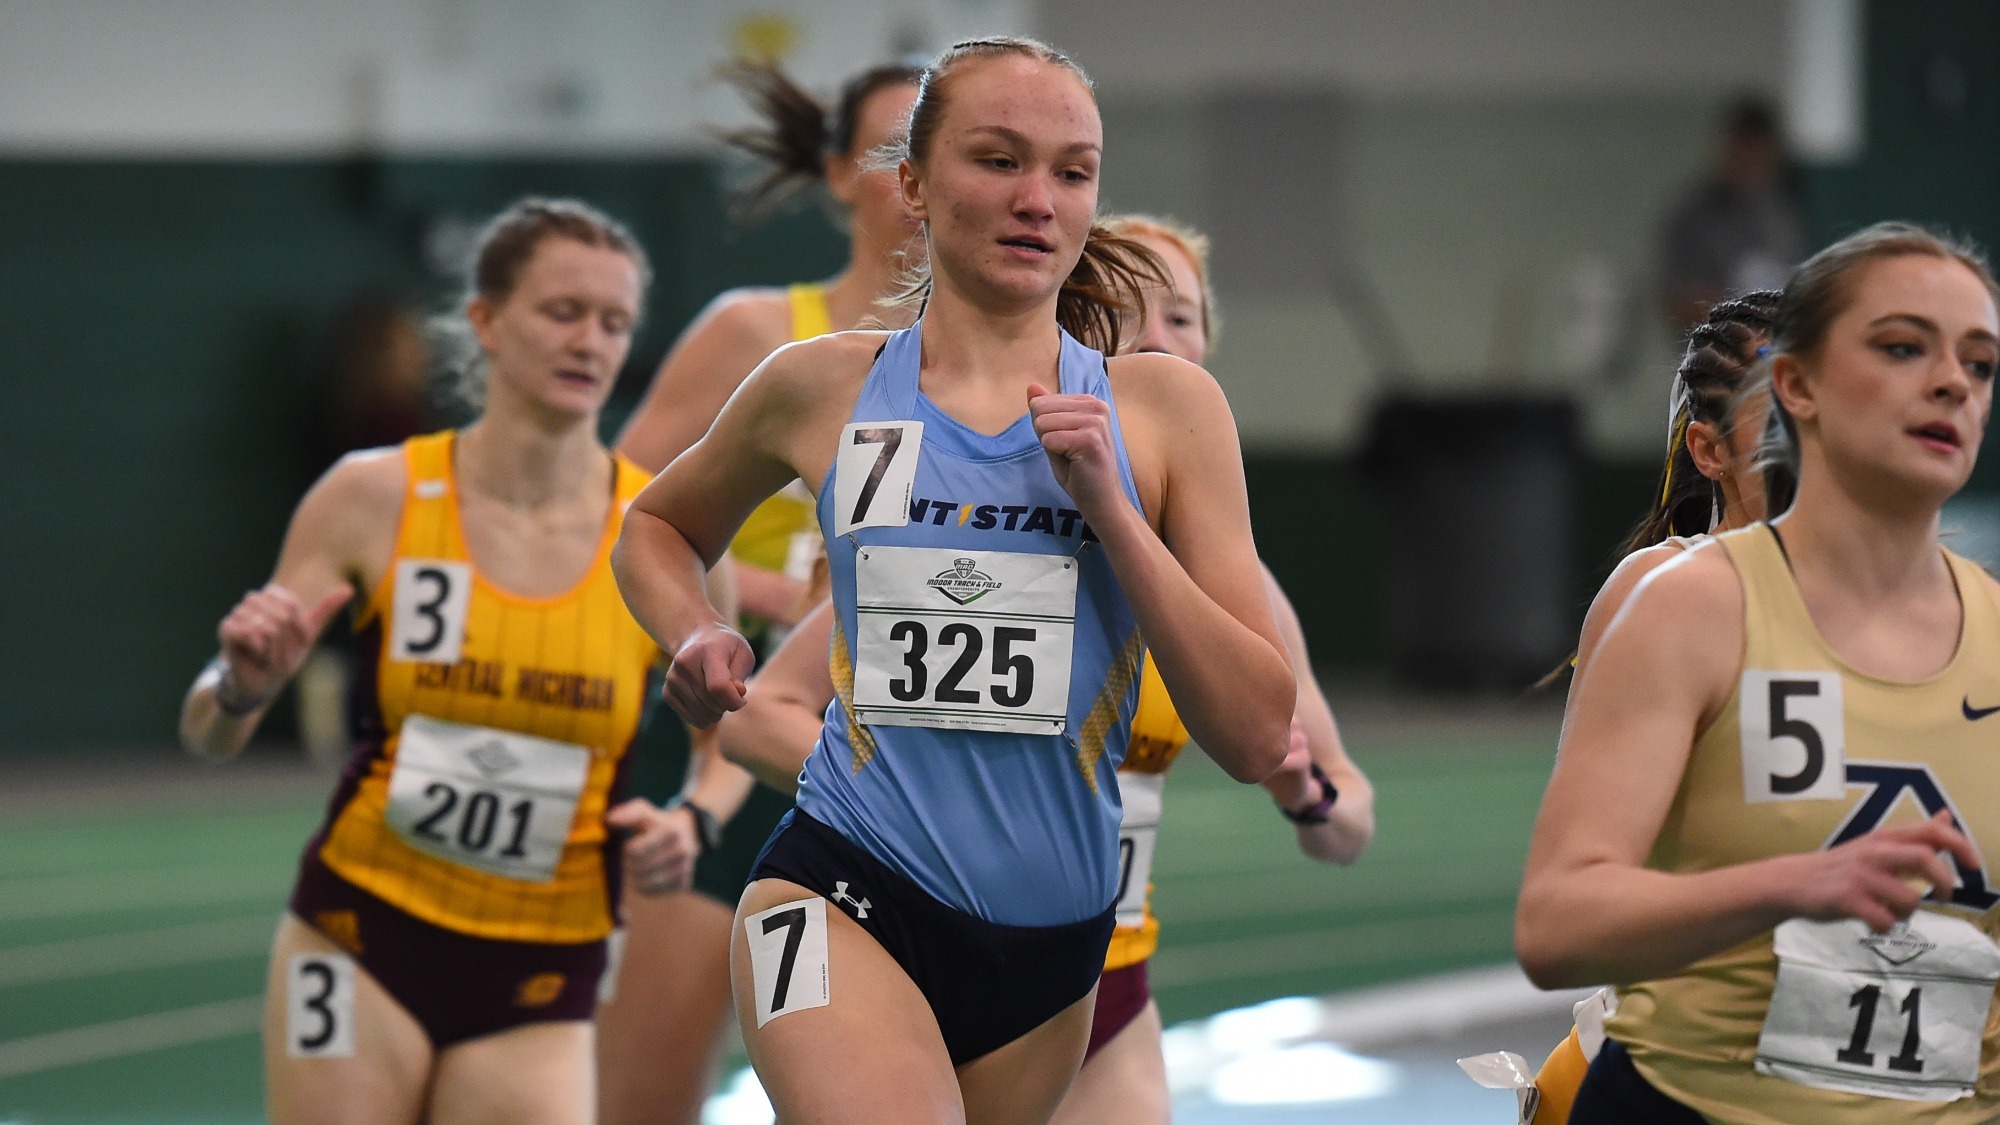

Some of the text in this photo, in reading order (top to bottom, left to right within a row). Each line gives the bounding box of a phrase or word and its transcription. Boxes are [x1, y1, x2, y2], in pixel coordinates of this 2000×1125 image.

[851, 427, 904, 526] 7
[909, 498, 959, 527] NT
[406, 567, 452, 655] 3
[888, 620, 1038, 708] 325
[1768, 680, 1825, 794] 5
[413, 782, 536, 860] 201
[761, 906, 807, 1015] 7
[298, 961, 336, 1050] 3
[1836, 983, 1925, 1074] 11
